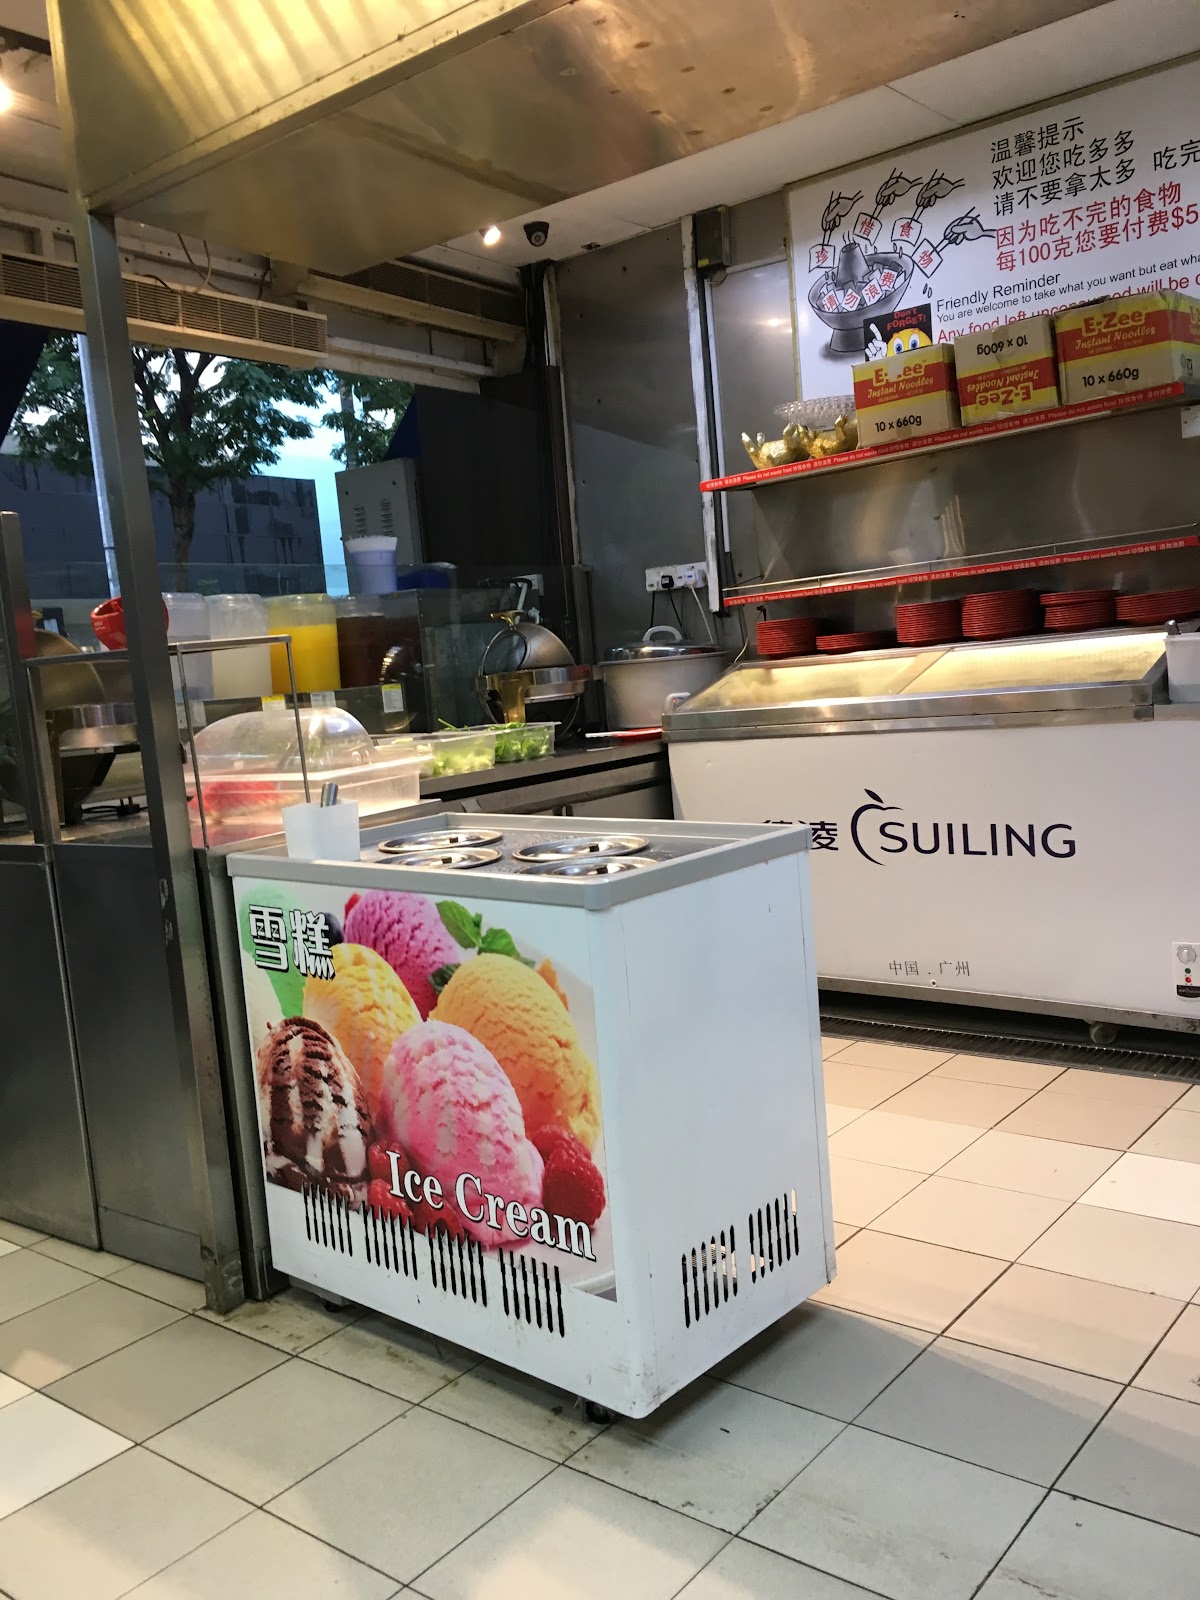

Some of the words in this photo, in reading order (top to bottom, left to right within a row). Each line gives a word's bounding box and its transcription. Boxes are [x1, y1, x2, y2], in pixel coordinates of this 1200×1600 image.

[991, 116, 1084, 164] 温馨提示
[992, 130, 1135, 190] 欢迎您吃多多
[993, 158, 1136, 217] 请不要拿太多
[996, 181, 1181, 250] 因为吃不完的食物
[815, 248, 829, 265] 珍
[859, 218, 875, 237] 惜
[900, 221, 913, 238] 食
[919, 250, 933, 269] 物
[996, 203, 1199, 272] 每100克您要付费$5
[823, 293, 839, 311] 请
[844, 292, 859, 309] 勿
[865, 284, 880, 302] 浪
[880, 271, 895, 288] 费
[936, 290, 988, 312] Friendly
[993, 273, 1060, 298] Reminder
[937, 311, 955, 323] You
[957, 308, 973, 319] are
[975, 298, 1019, 315] welcome
[1021, 295, 1031, 304] to
[1034, 288, 1056, 301] take
[1059, 281, 1084, 295] what
[1087, 277, 1106, 290] you
[1109, 268, 1136, 283] want
[1139, 263, 1157, 276] but
[1160, 258, 1178, 271] eat
[1168, 276, 1189, 290] be
[886, 314, 926, 331] FORGET!
[893, 308, 917, 320] Don't
[1006, 338, 1013, 347] x
[1016, 334, 1028, 347] 10
[1075, 335, 1111, 350] Instant
[1113, 325, 1156, 342] Noodles
[867, 383, 897, 398] Instant
[899, 376, 934, 391] Noodles
[874, 362, 923, 382] E-ee
[966, 376, 1004, 393] Noodles
[1005, 369, 1039, 384] Instant
[1082, 375, 1095, 387] 10
[1098, 375, 1105, 384] x
[1108, 368, 1139, 382] 660g
[875, 421, 885, 432] 10
[888, 421, 895, 430] x
[896, 415, 922, 428] 660g
[879, 822, 1076, 858] SUILING
[249, 904, 336, 980] 雪糕
[386, 1150, 444, 1210] Ice
[455, 1172, 597, 1262] Cream
